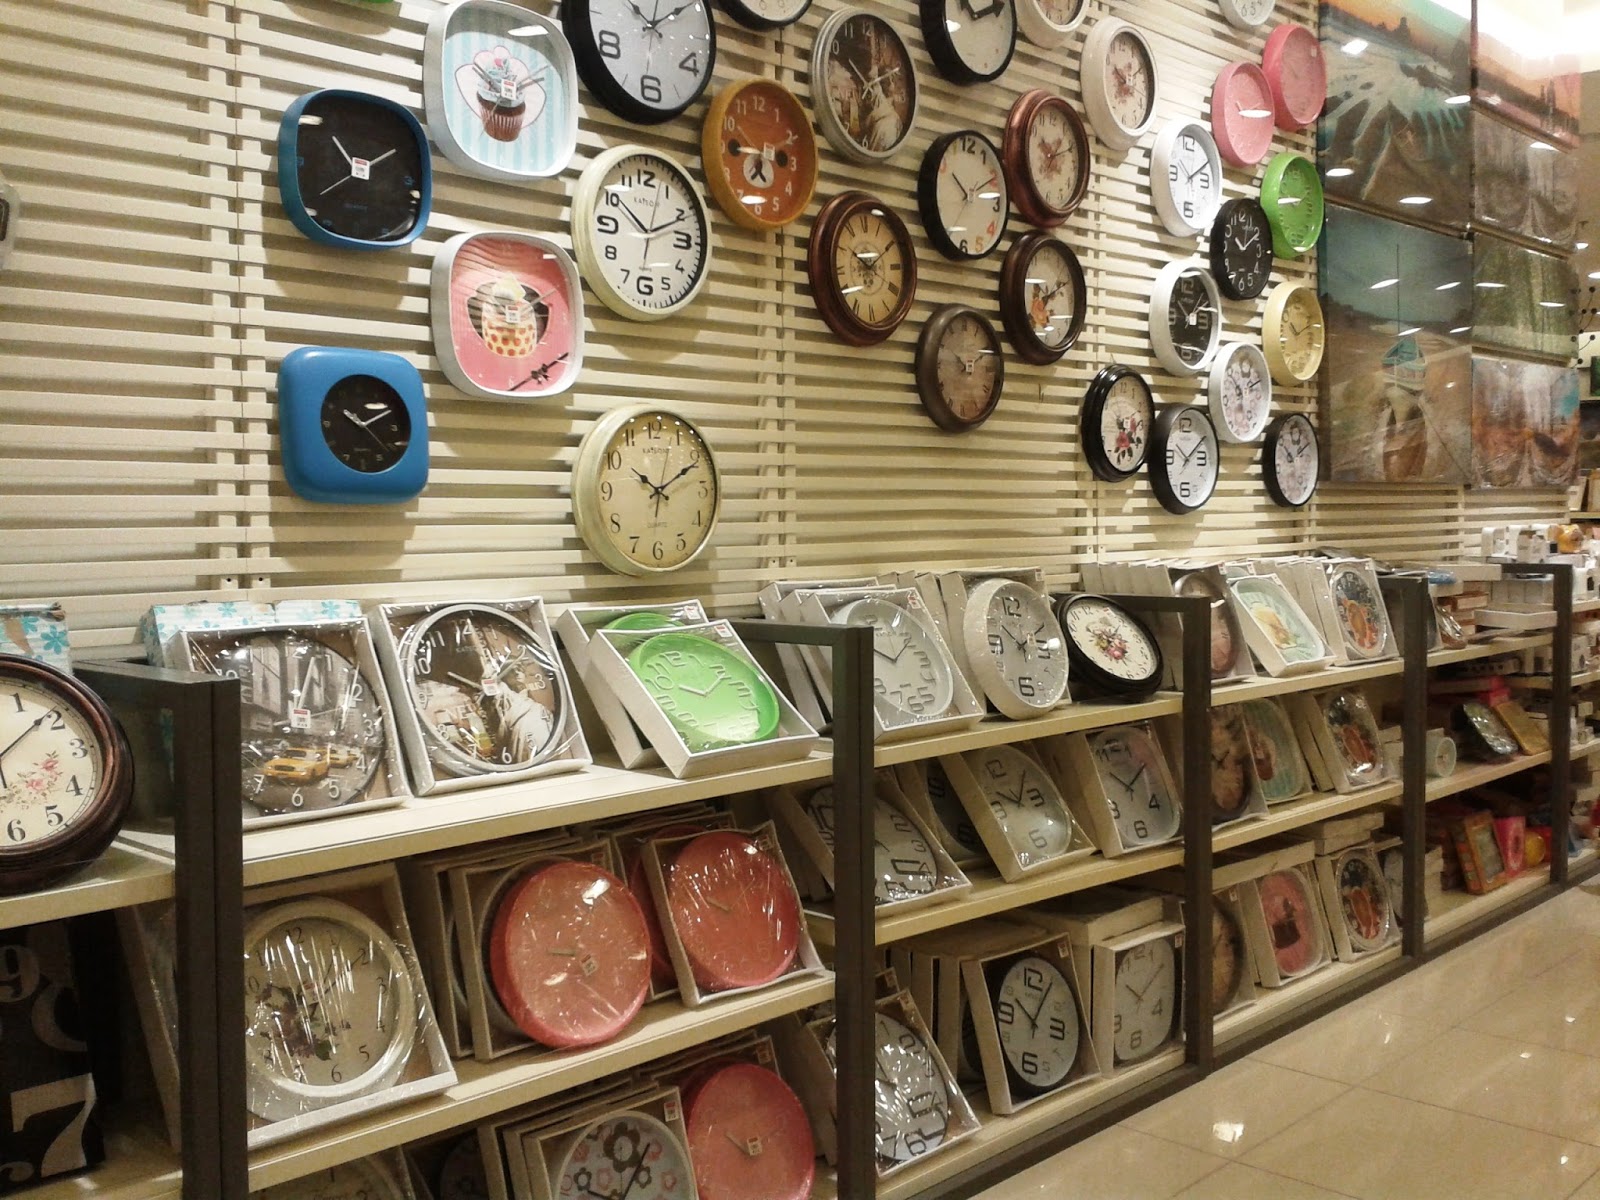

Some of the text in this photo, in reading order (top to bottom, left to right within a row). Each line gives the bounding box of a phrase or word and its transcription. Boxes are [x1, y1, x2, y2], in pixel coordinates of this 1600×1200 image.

[599, 30, 620, 59] 8
[679, 52, 699, 77] 4
[641, 75, 661, 103] 6
[736, 100, 747, 115] 11
[753, 96, 765, 112] 12
[724, 116, 735, 131] 10
[862, 134, 869, 150] 6
[960, 137, 976, 155] 12
[790, 157, 796, 172] 3
[981, 149, 987, 165] 1
[637, 169, 656, 188] 12
[1199, 173, 1209, 189] 3
[785, 181, 792, 196] 4
[606, 191, 620, 207] 10
[772, 197, 780, 212] 5
[676, 208, 687, 221] 2
[1183, 201, 1194, 219] 6
[597, 215, 619, 235] 9
[987, 221, 995, 238] 4
[673, 231, 692, 250] 3
[605, 245, 617, 260] 8
[1256, 243, 1262, 258] 3
[675, 259, 685, 274] 4
[1253, 262, 1259, 275] 4
[620, 268, 630, 284] 7
[661, 277, 672, 290] 5
[1238, 279, 1245, 291] 6
[1247, 273, 1254, 287] 5
[637, 276, 653, 295] 6
[648, 420, 662, 440] 12
[675, 429, 681, 446] 1
[607, 450, 622, 471] 10
[1196, 450, 1207, 468] 3
[601, 481, 613, 502] 9
[1179, 481, 1191, 499] 6
[610, 512, 620, 534] 8
[691, 510, 701, 528] 4
[629, 536, 640, 554] 7
[652, 540, 664, 560] 6
[676, 533, 686, 551] 5
[913, 650, 931, 668] 3
[536, 672, 547, 690] 3
[728, 680, 752, 699] 3
[1018, 676, 1035, 697] 6
[10, 692, 25, 713] 1
[907, 695, 924, 713] 6
[917, 686, 936, 704] 5
[46, 710, 65, 731] 2
[364, 719, 375, 737] 3
[70, 738, 88, 759] 3
[501, 746, 513, 765] 6
[355, 752, 366, 772] 4
[65, 774, 83, 797] 4
[292, 787, 304, 807] 6
[1026, 787, 1044, 807] 3
[1148, 792, 1160, 811] 4
[45, 804, 64, 828] 5
[890, 814, 911, 833] 2
[7, 818, 26, 842] 6
[1133, 820, 1147, 839] 6
[1151, 998, 1163, 1016] 4
[1050, 1018, 1065, 1041] 3
[358, 1043, 371, 1063] 5
[330, 1062, 343, 1083] 6
[1022, 1052, 1038, 1075] 6
[10, 1073, 97, 1179] 7
